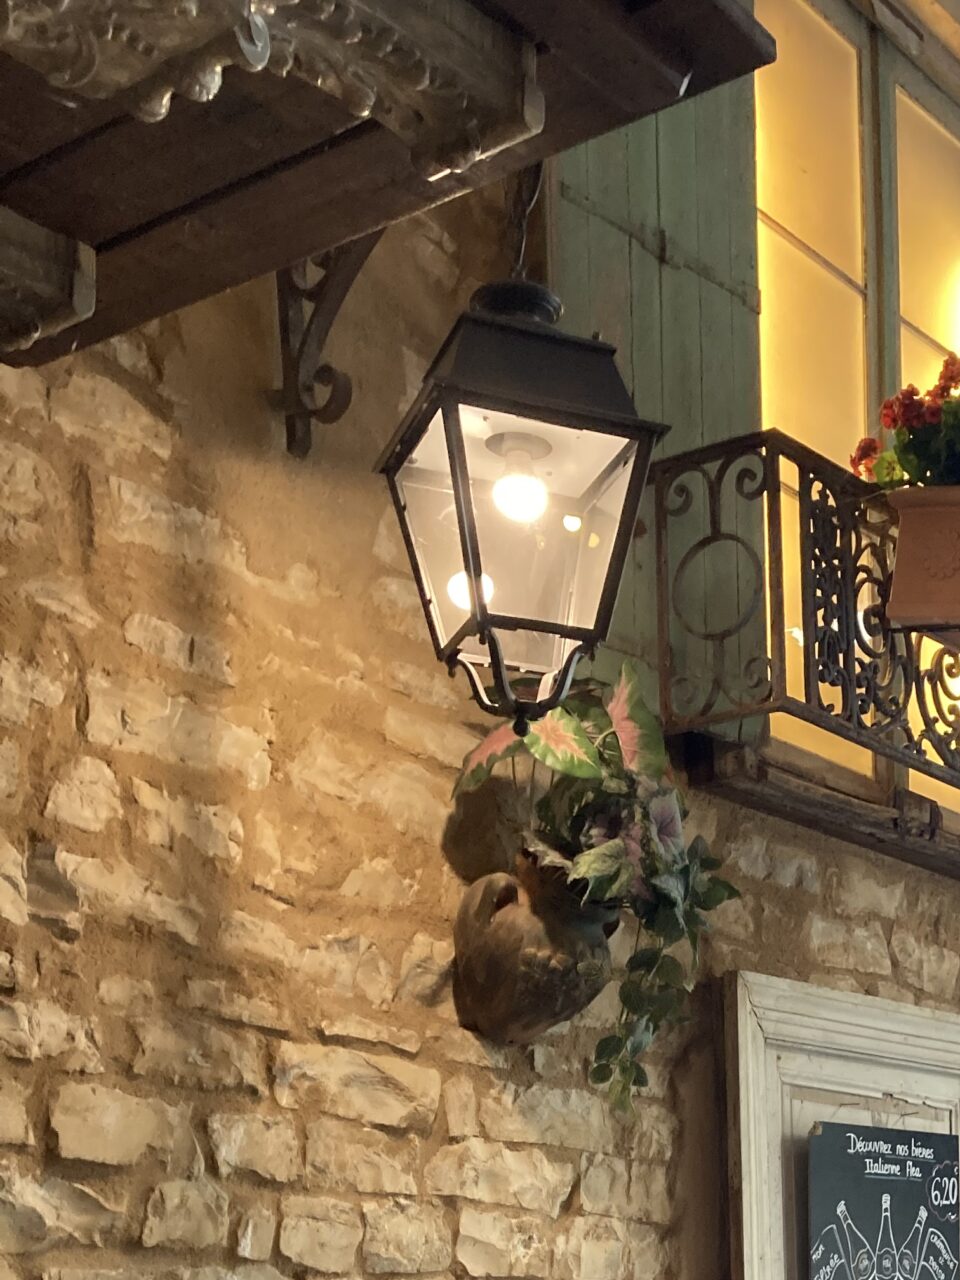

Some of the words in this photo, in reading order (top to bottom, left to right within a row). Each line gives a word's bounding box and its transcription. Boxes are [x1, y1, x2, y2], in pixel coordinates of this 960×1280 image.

[896, 1144, 909, 1156] nos
[864, 1157, 900, 1175] Italienne
[931, 1177, 958, 1207] 6,20
